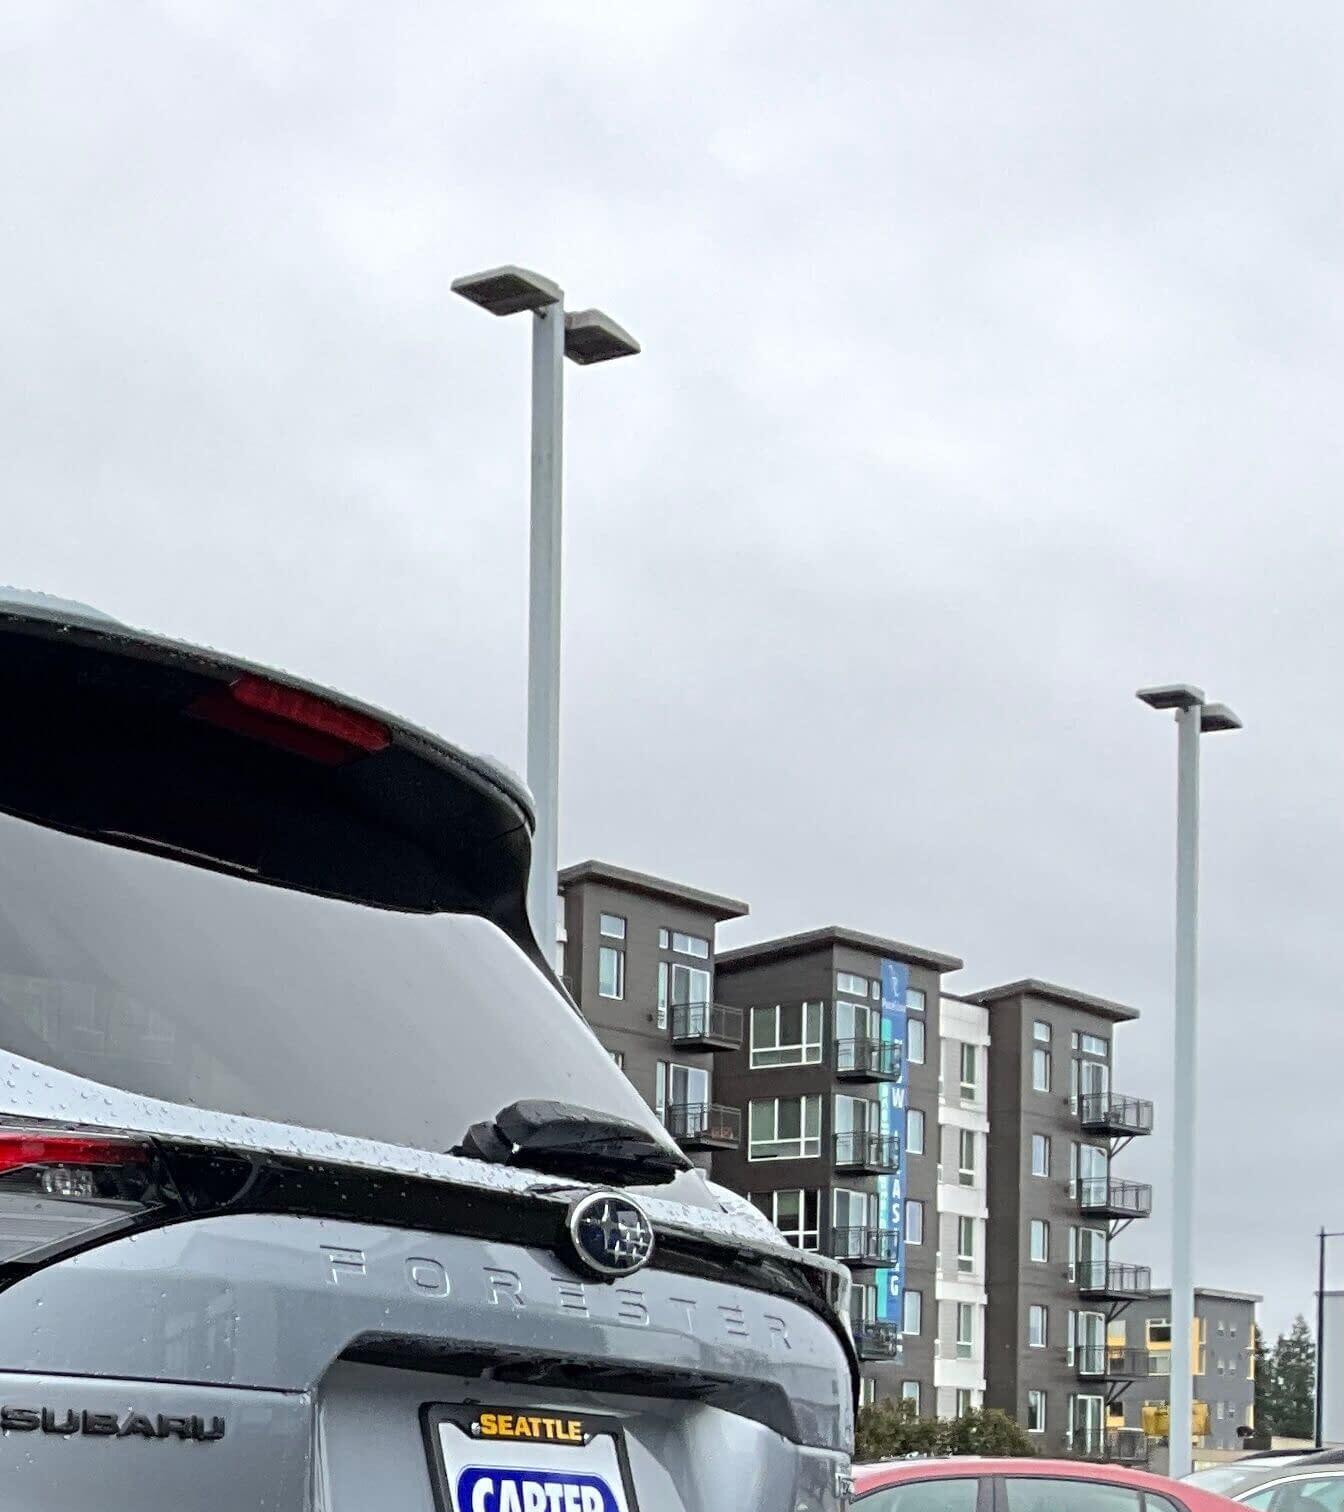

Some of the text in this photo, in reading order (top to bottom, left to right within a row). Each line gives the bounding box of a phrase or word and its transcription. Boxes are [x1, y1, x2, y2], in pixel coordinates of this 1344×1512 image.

[319, 1243, 792, 1350] FORESTER
[0, 1404, 225, 1440] SUBARU
[479, 1413, 582, 1441] SEATTLE
